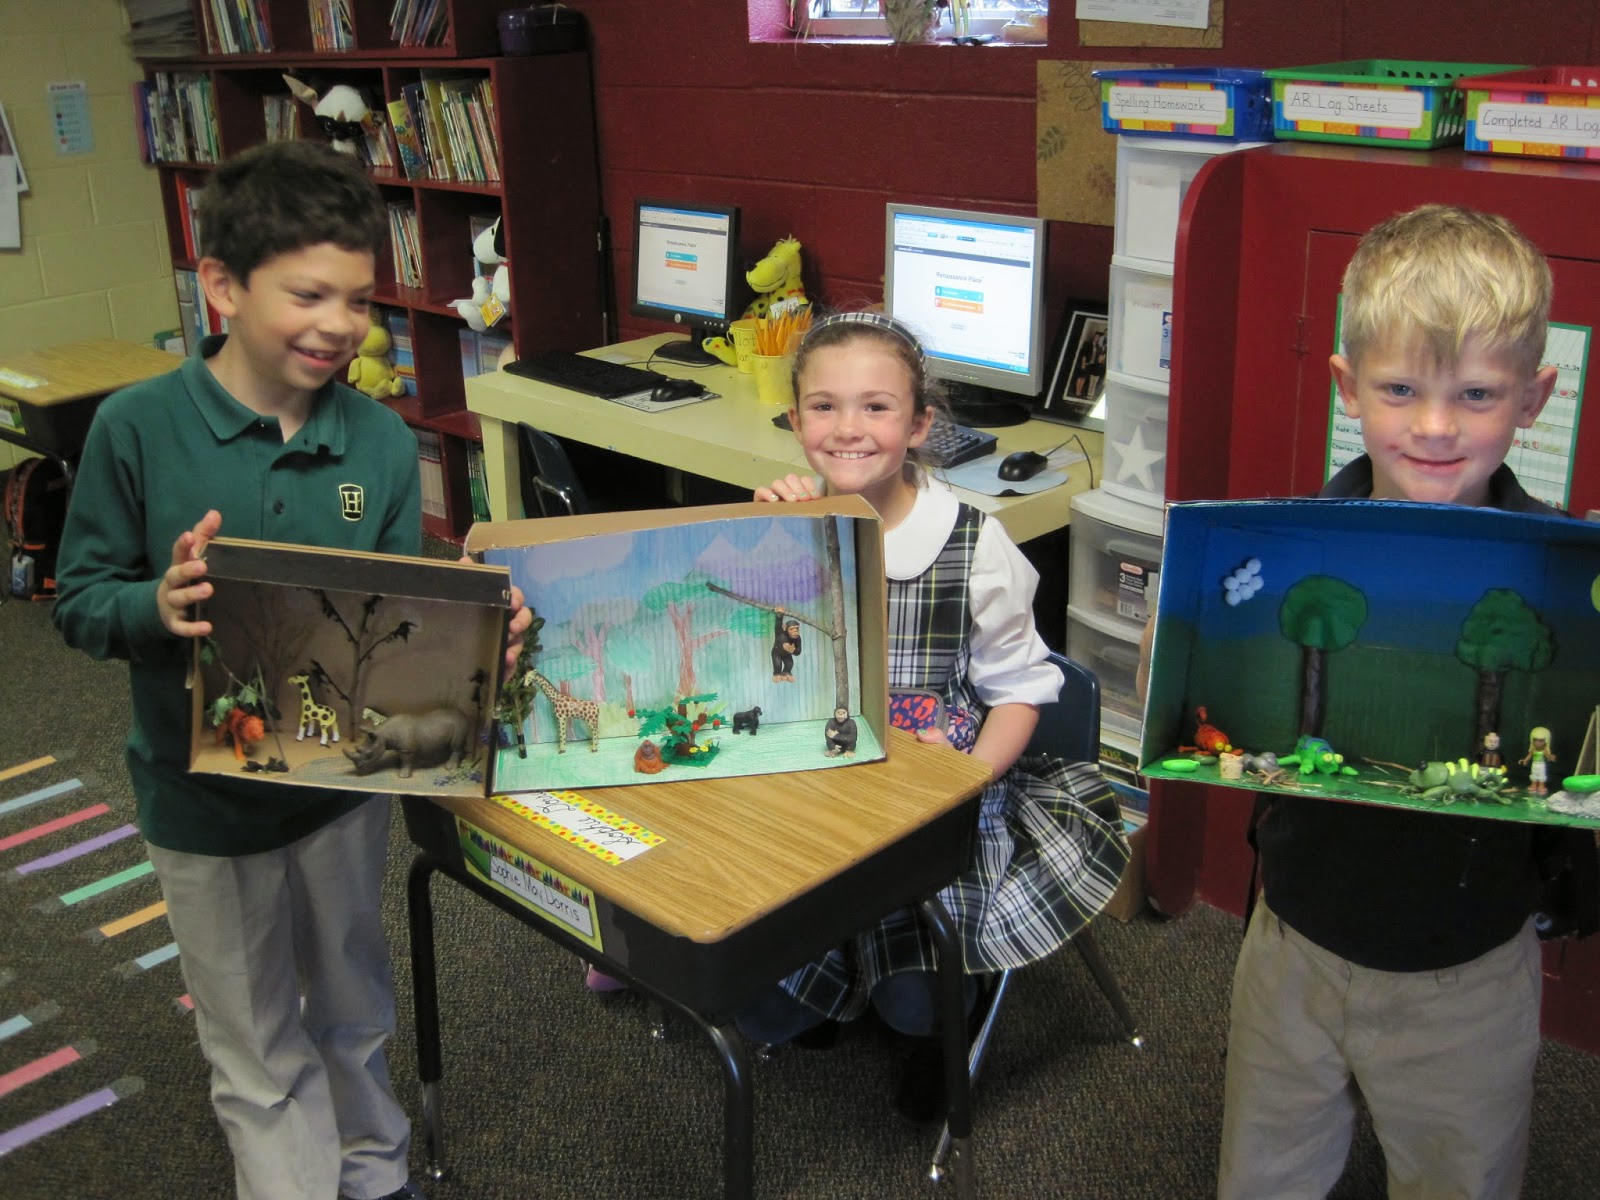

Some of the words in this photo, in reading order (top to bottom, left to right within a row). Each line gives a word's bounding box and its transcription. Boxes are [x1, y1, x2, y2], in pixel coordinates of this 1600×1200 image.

[1115, 93, 1149, 113] Spelling
[1153, 95, 1205, 110] Homework
[1290, 92, 1311, 107] AR
[1317, 94, 1341, 116] Log
[1347, 95, 1388, 112] Sheets
[1482, 109, 1541, 132] Completed
[1550, 114, 1569, 130] AR
[1162, 328, 1169, 338] 3
[1119, 572, 1126, 583] 3
[492, 858, 521, 886] Sophie
